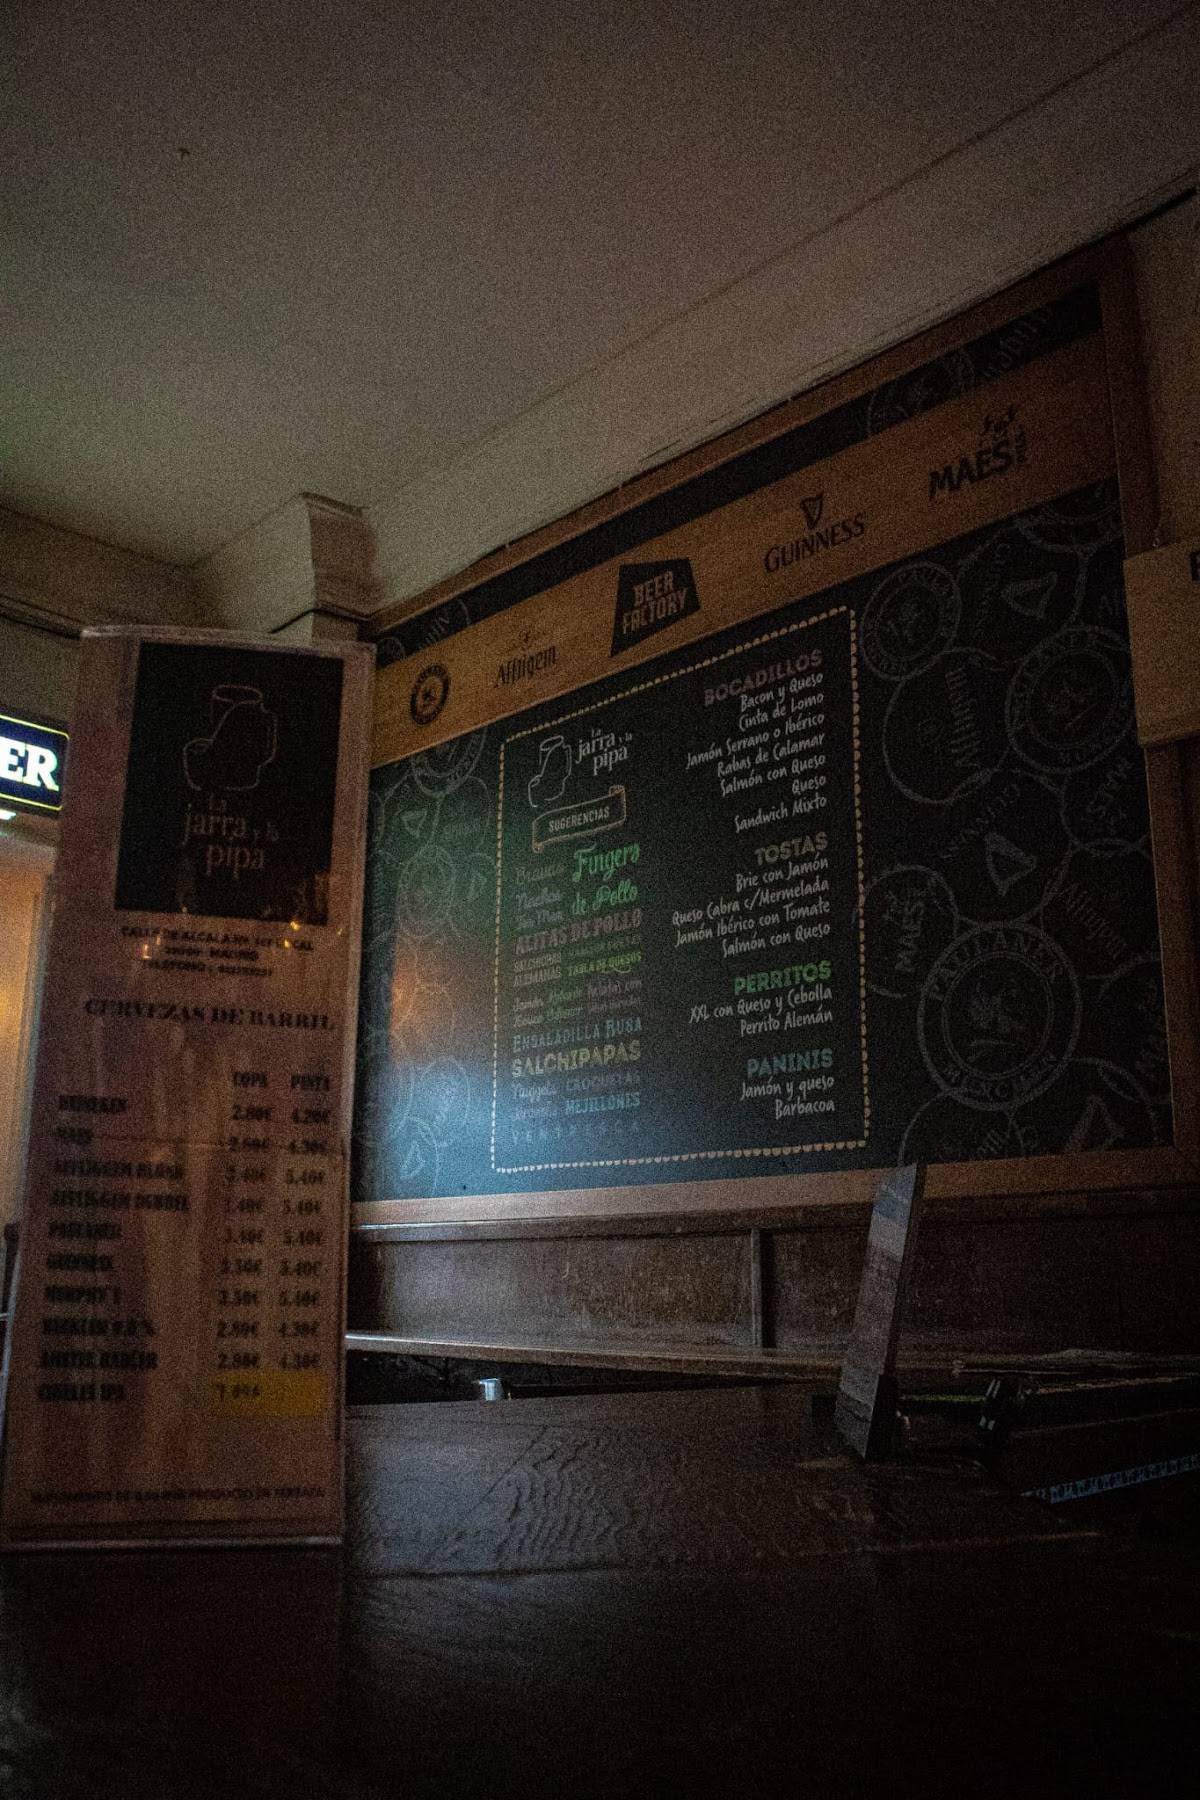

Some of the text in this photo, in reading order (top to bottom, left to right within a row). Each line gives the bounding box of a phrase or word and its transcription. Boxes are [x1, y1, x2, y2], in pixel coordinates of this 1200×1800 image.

[929, 437, 1010, 500] MAES
[765, 512, 865, 574] GUINNESS
[633, 569, 675, 607] BEER
[622, 588, 688, 635] FACTORY
[493, 645, 556, 690] Affligem
[704, 649, 823, 706] BOCADILLOS
[739, 693, 824, 732] Cinta de Lomo
[740, 673, 824, 713] Bacon y Queso
[575, 730, 616, 765] jarra
[592, 744, 629, 777] pipa
[685, 712, 825, 770] Jamón Serrano o Ibérico
[717, 733, 825, 778] Rabas de Calamar
[720, 754, 826, 797] Salmón con Queso
[792, 775, 827, 795] Queso
[182, 802, 248, 847] jarra
[549, 805, 610, 832] SUGERENCIAS
[734, 791, 828, 834] Sandwich Mixto
[205, 843, 267, 880] pipa
[572, 842, 640, 882] Fingers
[754, 831, 829, 866] TOSTAS
[736, 852, 829, 893] Brie con Jamón
[571, 878, 639, 915] de Pollo
[672, 875, 830, 927] Queso Cabra c/Mermelada
[516, 929, 568, 957] ALITAS
[570, 921, 592, 944] DE
[593, 908, 642, 937] POLLO
[674, 896, 831, 948] Jamón Ibérico con Tomate
[722, 923, 831, 959] Salmón con Queso
[734, 959, 833, 996] PERRITOS
[84, 998, 336, 1032] CERVEZAS DE BARRIL
[688, 983, 833, 1024] XXL con Queso y Cebolla
[740, 1004, 833, 1037] Perrito Alemán
[513, 1022, 600, 1053] ENSALADILLA
[605, 1015, 643, 1040] RUSA
[511, 1038, 642, 1079] SALCHIPAPAS
[747, 1047, 833, 1078] PANINIS
[740, 1075, 835, 1101] Jamón y queso
[775, 1096, 835, 1121] Barbacoa
